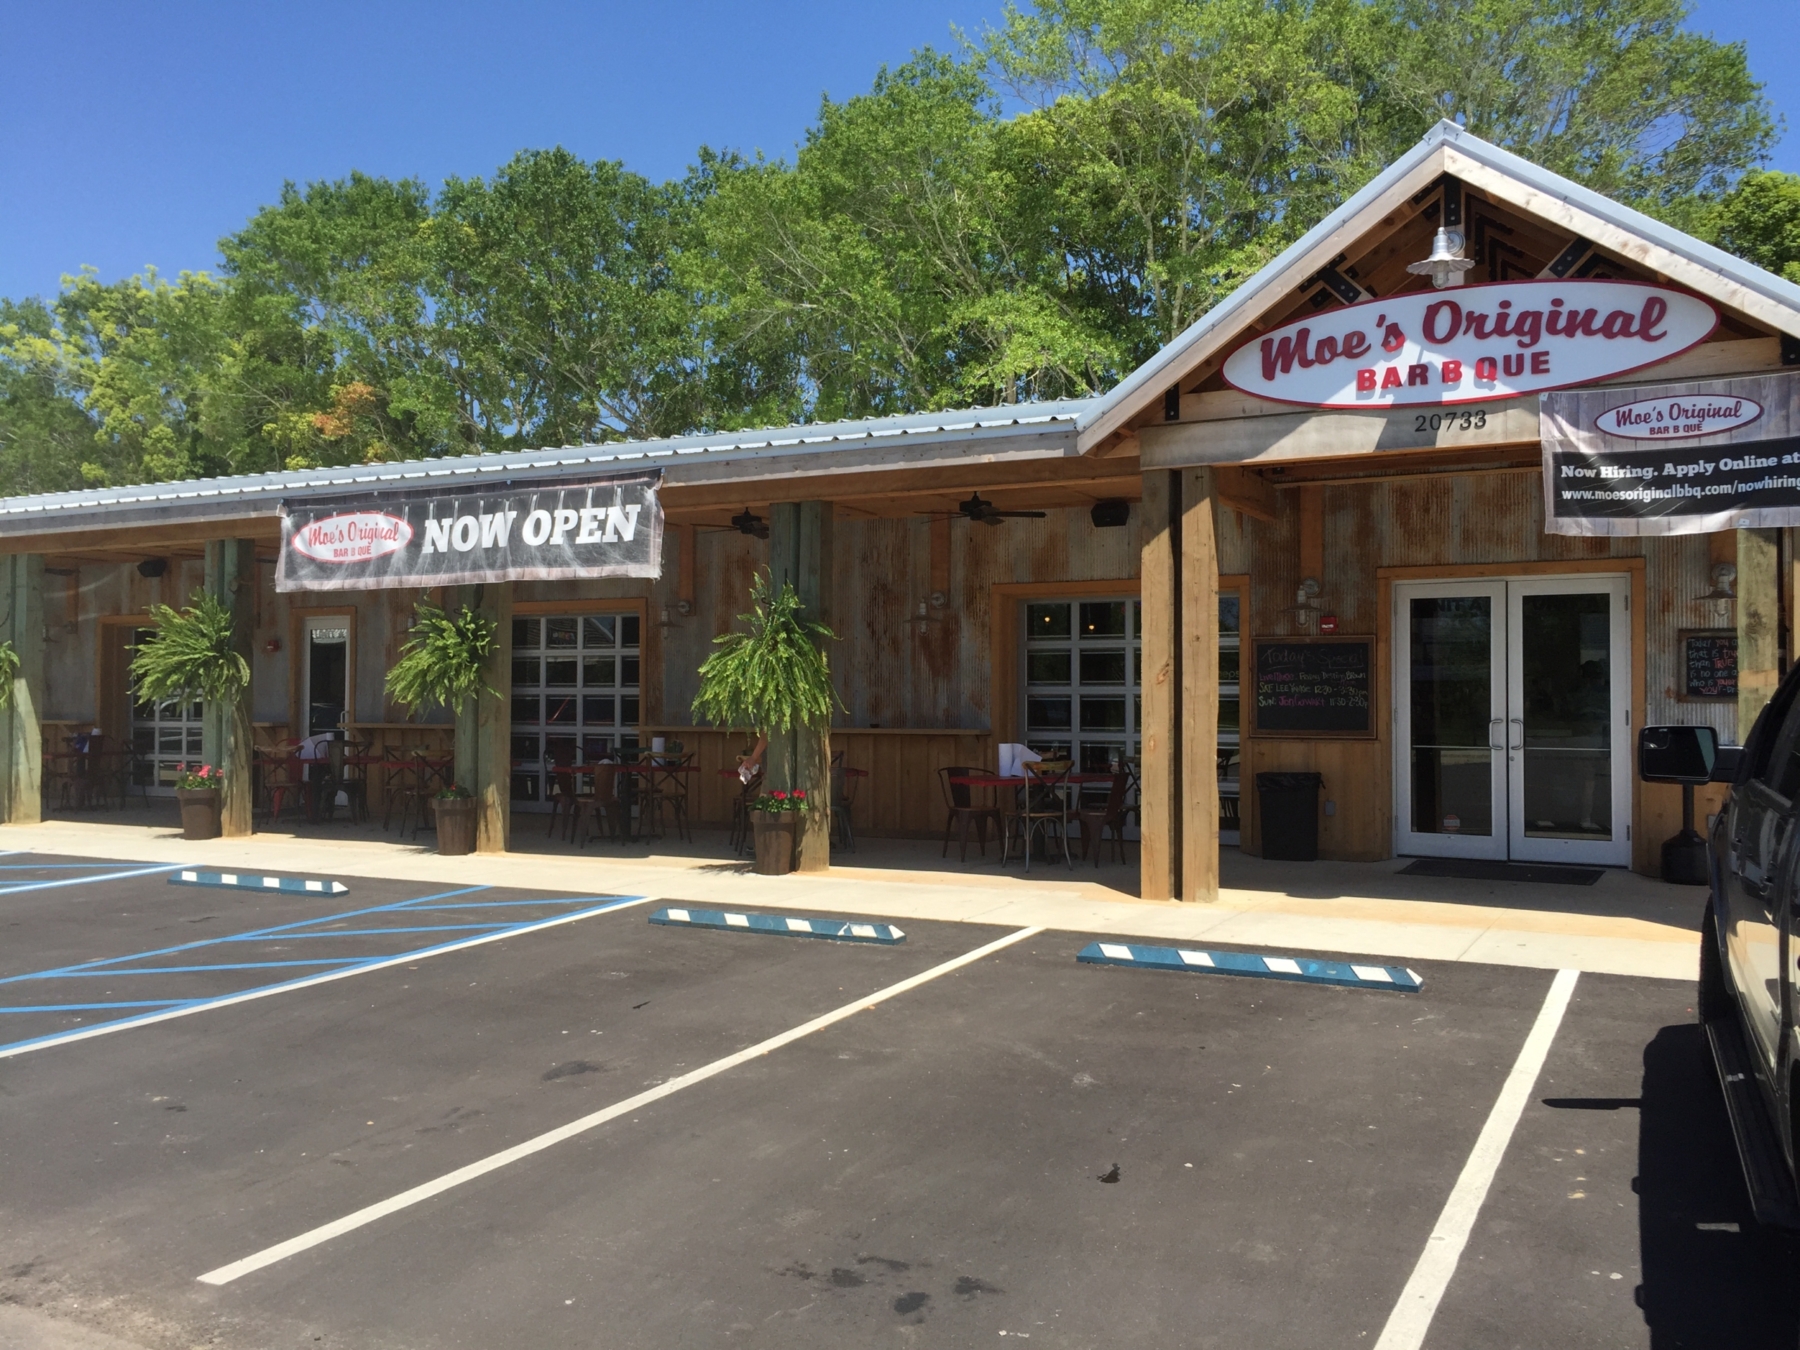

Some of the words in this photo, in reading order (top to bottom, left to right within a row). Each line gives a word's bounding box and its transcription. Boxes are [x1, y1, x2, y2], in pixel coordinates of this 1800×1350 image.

[1260, 314, 1405, 381] Moe's
[1422, 296, 1667, 348] Original
[1356, 363, 1429, 392] BAR
[1441, 360, 1463, 384] B
[1475, 350, 1550, 382] QUE
[1415, 409, 1487, 432] 20733
[1615, 406, 1664, 428] Moe's
[1668, 400, 1742, 423] Original
[1649, 426, 1670, 436] BAR
[1673, 425, 1680, 434] B
[1683, 423, 1703, 434] QUE
[1561, 465, 1597, 478] Now
[1599, 465, 1659, 480] Hiring.
[1662, 460, 1716, 478] Apply
[1719, 455, 1778, 471] Online
[1782, 452, 1800, 464] at
[307, 524, 344, 548] Moe's
[347, 521, 399, 545] Original
[422, 510, 517, 554] NOW
[522, 504, 641, 547] OPEN
[333, 547, 348, 558] BAR
[351, 547, 356, 556] B
[357, 546, 371, 556] QUE
[1688, 648, 1709, 658] that
[1700, 670, 1710, 678] no
[1713, 670, 1728, 678] one
[1275, 683, 1289, 692] LEE
